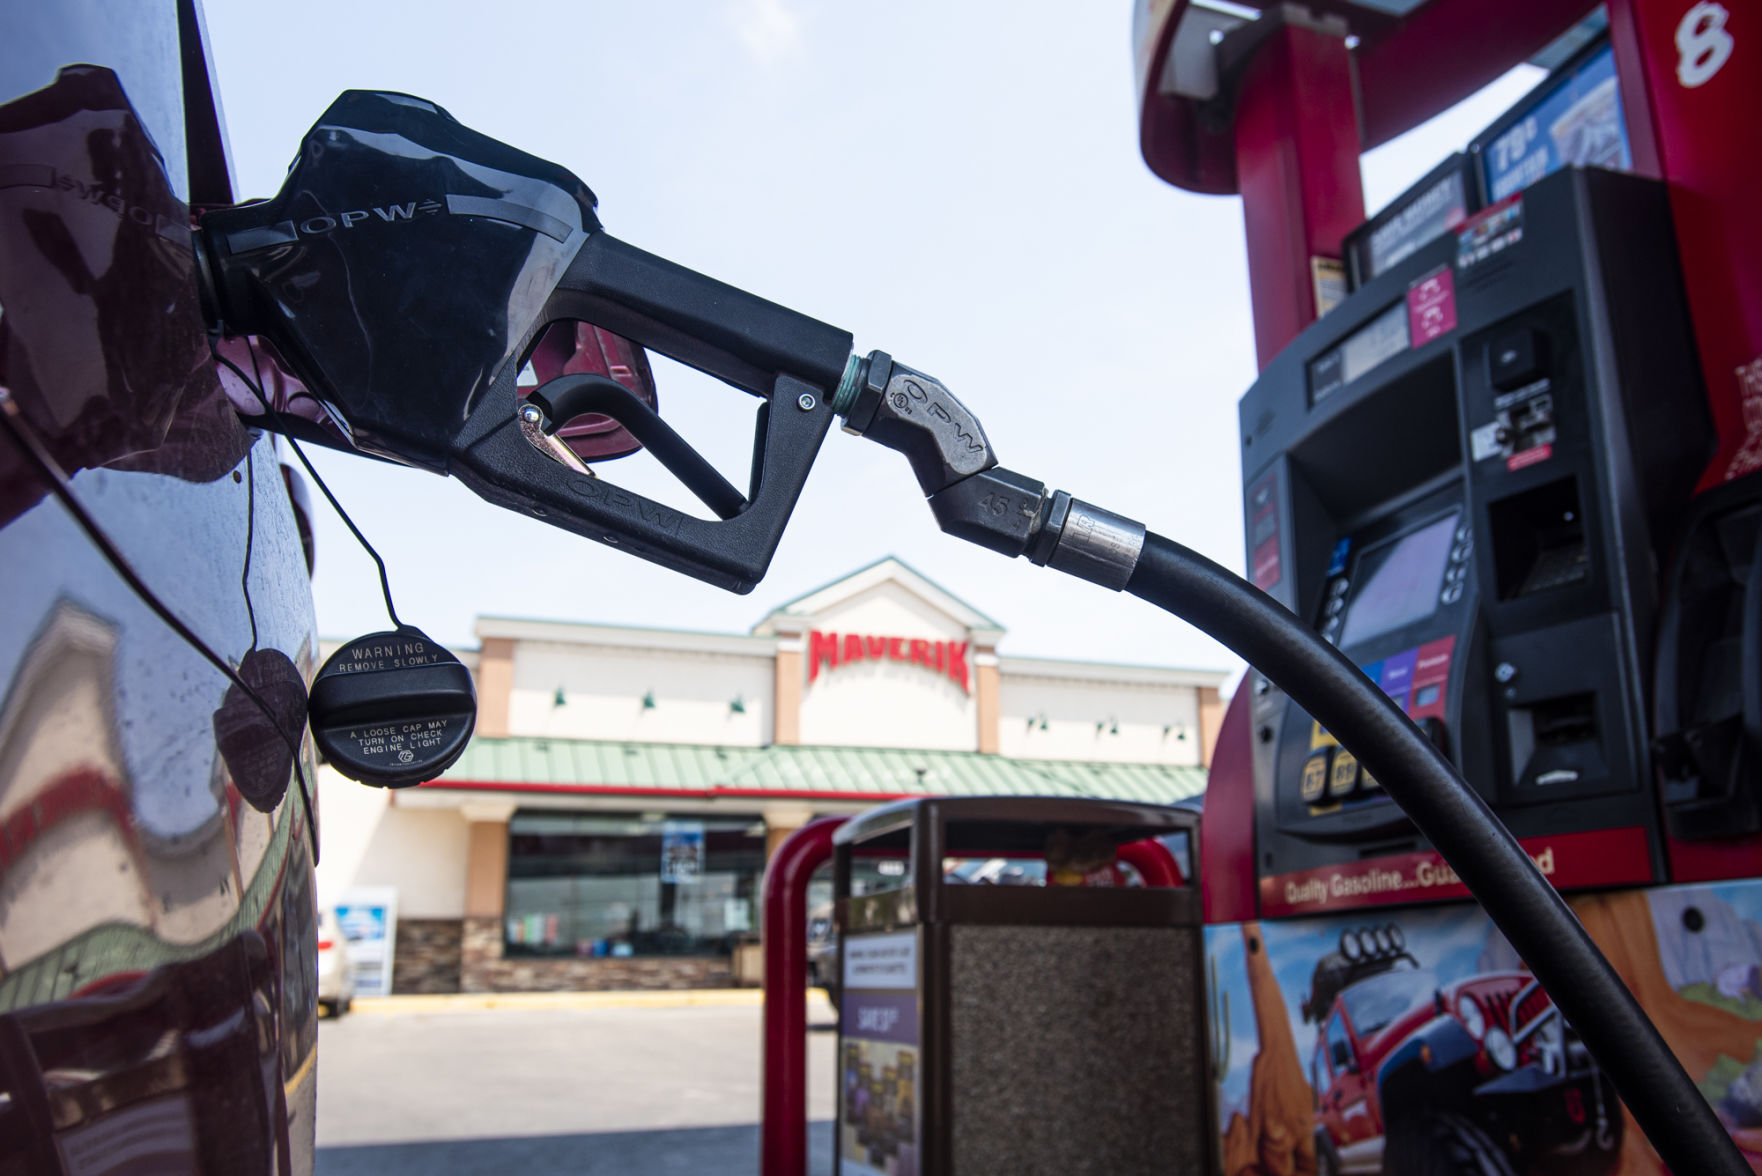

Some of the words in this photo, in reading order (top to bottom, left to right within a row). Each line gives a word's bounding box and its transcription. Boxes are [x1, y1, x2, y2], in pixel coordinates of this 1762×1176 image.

[1674, 0, 1734, 88] 8
[301, 202, 416, 234] OPW
[903, 379, 983, 453] OPW
[352, 643, 424, 659] WARNING
[339, 661, 385, 672] REMOVE
[394, 654, 438, 667] SLOWLY
[808, 630, 970, 695] MAVERIK
[350, 731, 357, 739] A
[364, 727, 396, 738] LOOSE
[402, 724, 422, 733] CAP
[428, 720, 447, 729] MAY
[358, 738, 384, 746] TURN
[391, 735, 404, 743] ON
[411, 729, 443, 741] CHECK
[363, 743, 402, 755] ENGINE
[410, 737, 441, 749] LIGHT
[1285, 879, 1328, 905] Quality
